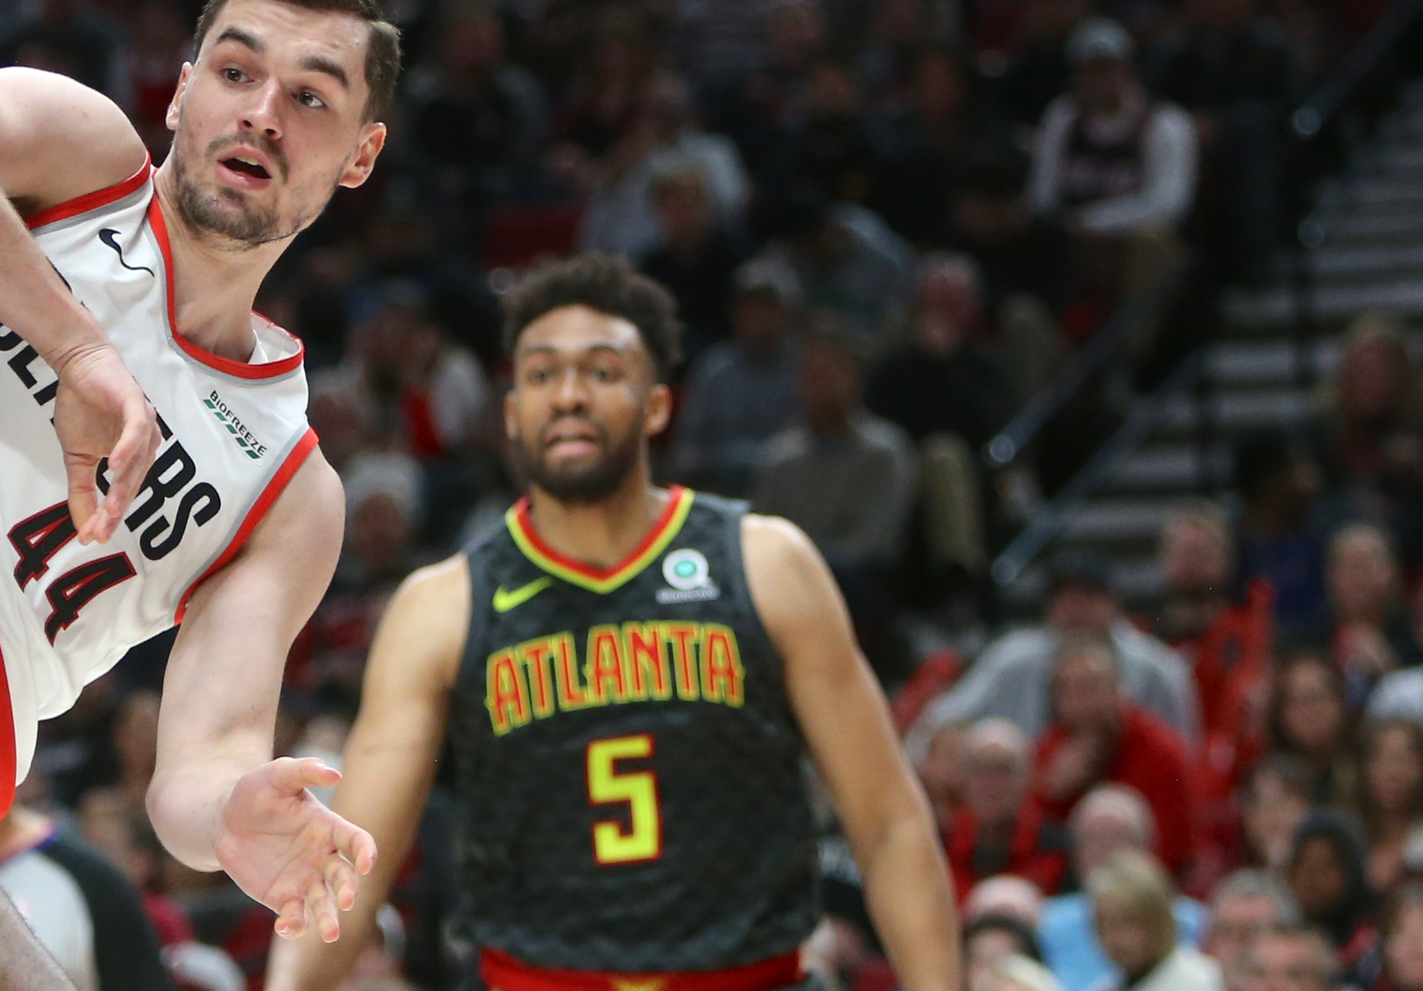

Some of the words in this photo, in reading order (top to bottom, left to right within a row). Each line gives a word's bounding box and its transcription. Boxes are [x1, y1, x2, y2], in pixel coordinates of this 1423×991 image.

[209, 389, 268, 457] BIOFREEZE
[7, 499, 138, 648] 44
[484, 620, 747, 737] ATLANTA
[585, 732, 663, 866] 5
